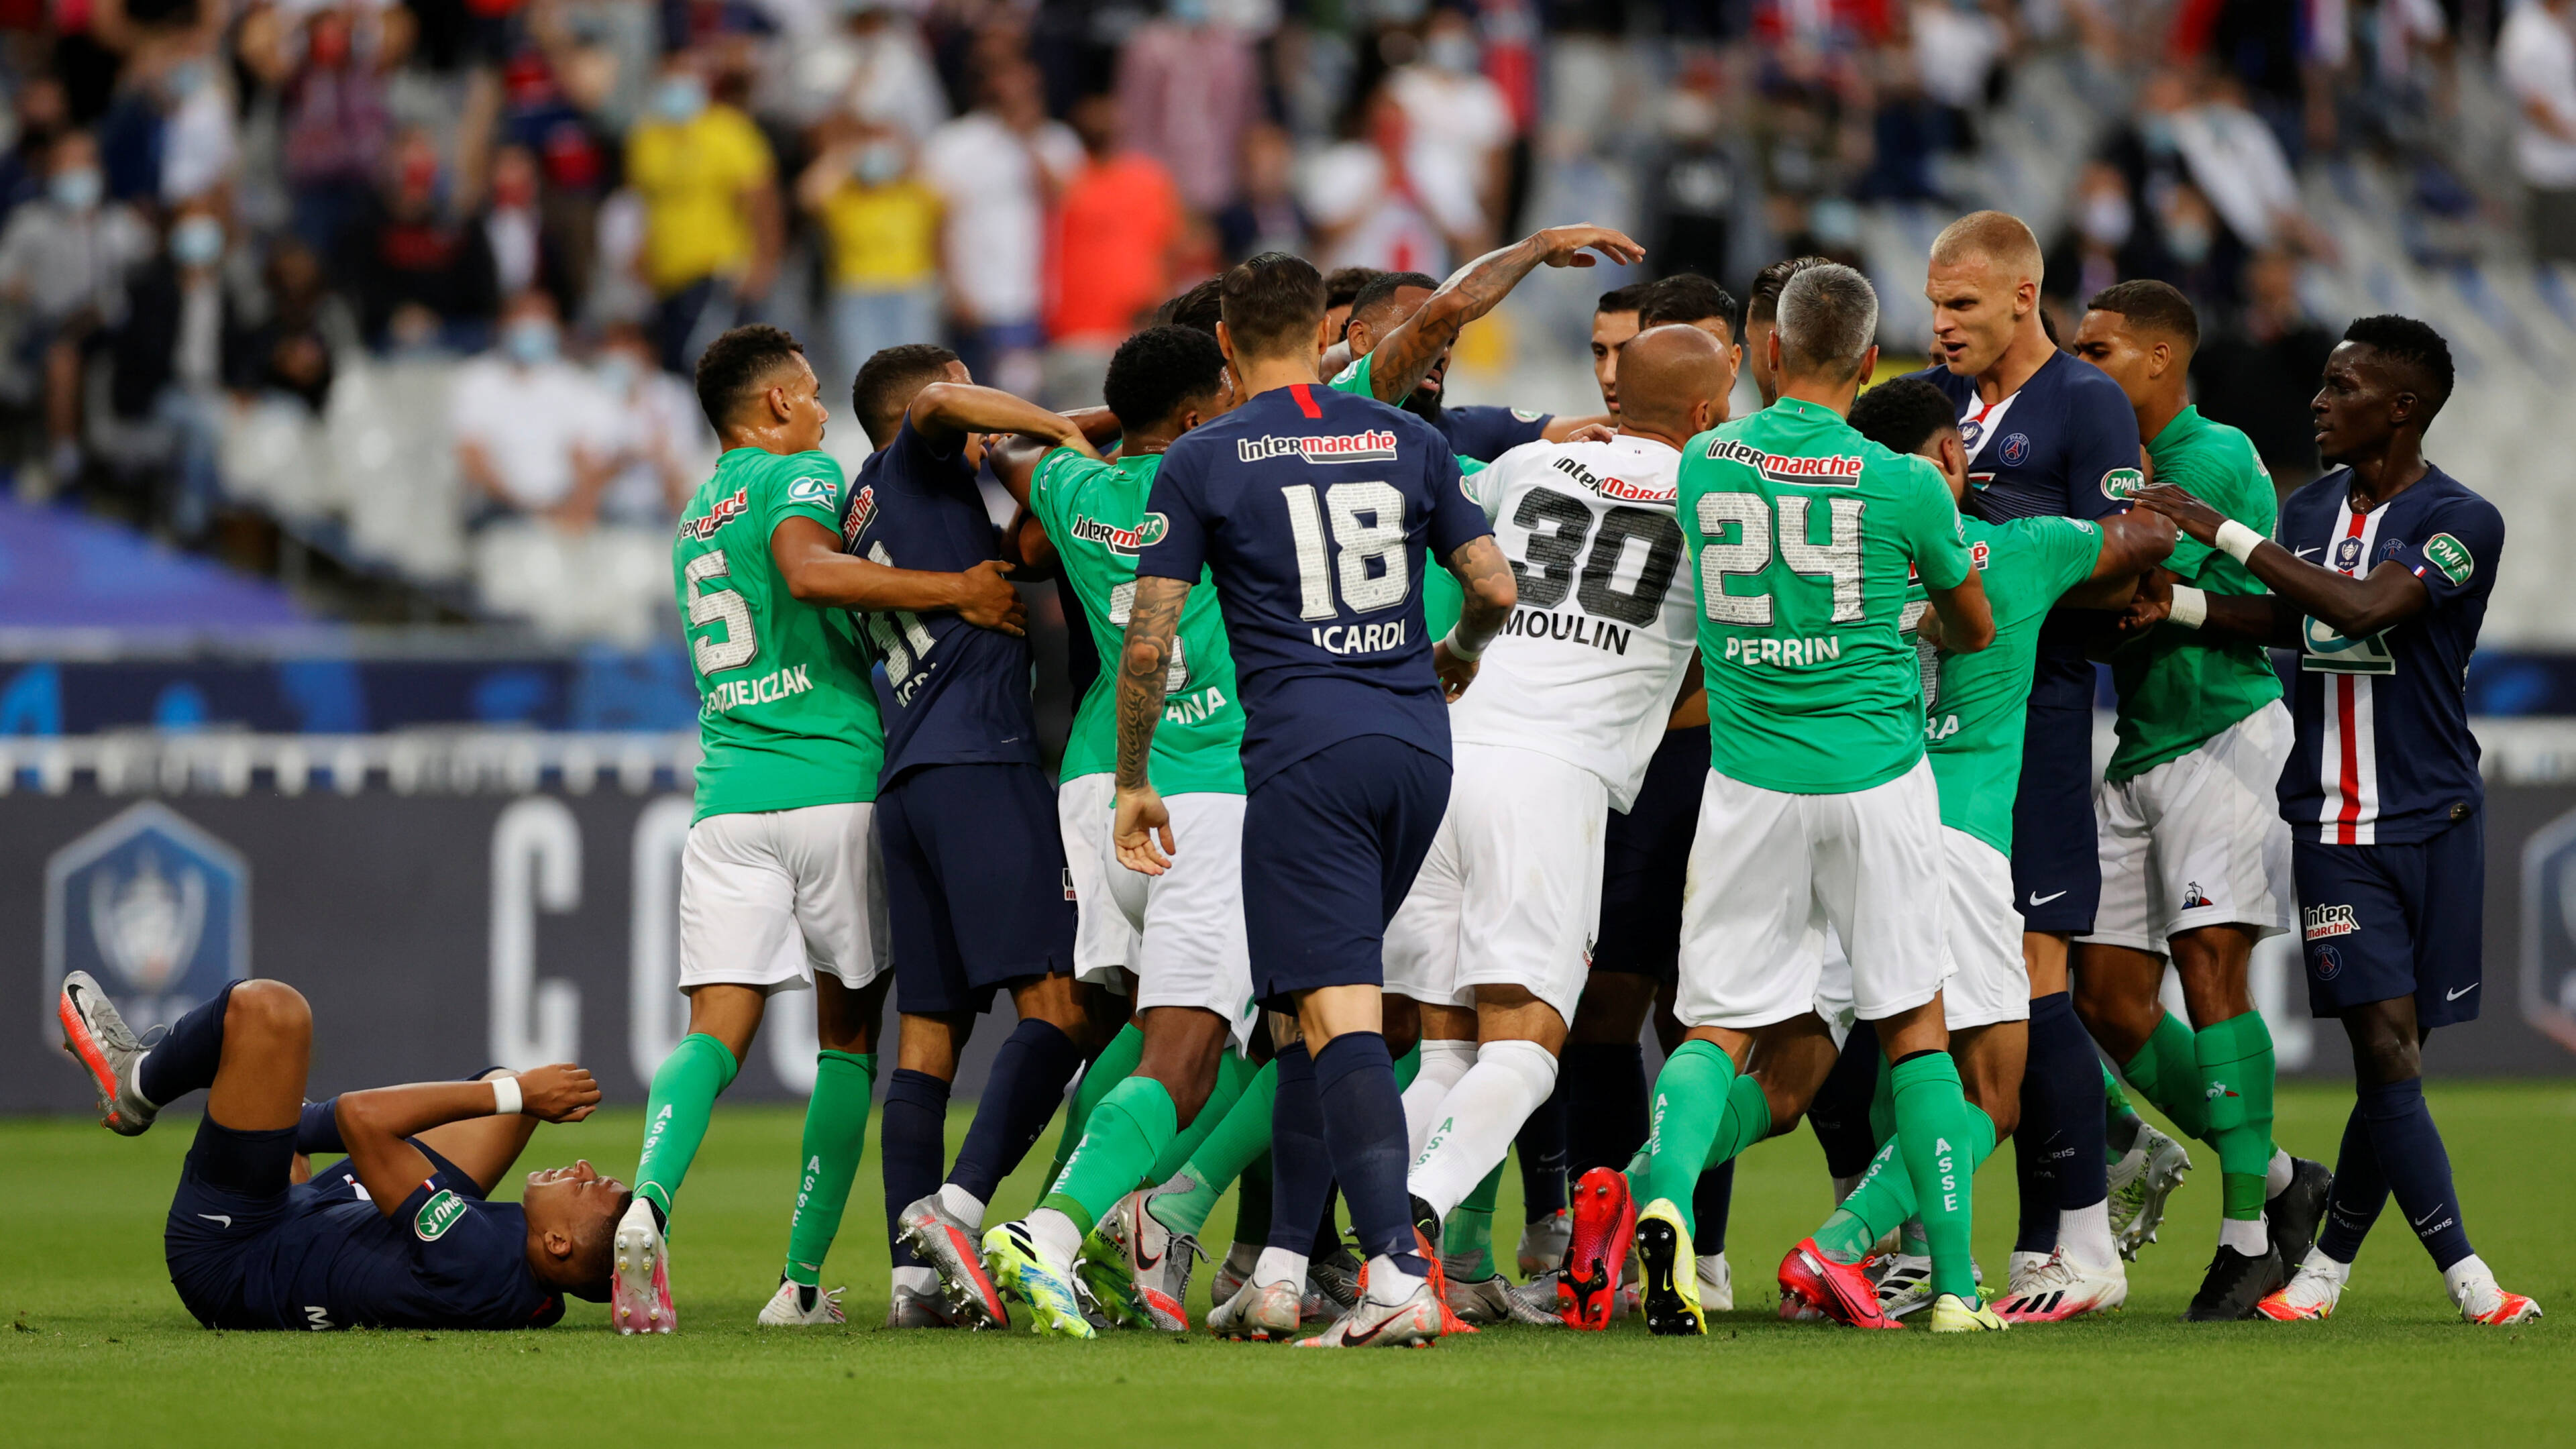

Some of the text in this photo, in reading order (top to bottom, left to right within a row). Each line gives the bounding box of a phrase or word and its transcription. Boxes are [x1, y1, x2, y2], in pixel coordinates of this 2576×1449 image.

[1281, 480, 1409, 622] 18
[1509, 486, 1685, 629] 30
[1696, 492, 1866, 627] 24
[2431, 539, 2465, 567] PMU
[684, 548, 758, 678] 5
[1311, 618, 1405, 654] ICARDI
[1499, 609, 1631, 656] MOULIN
[1725, 635, 1840, 667] PERRIN
[2306, 904, 2357, 928] Inter
[641, 1104, 672, 1165] ASSE
[1651, 1093, 1668, 1156] ASSE
[792, 1155, 820, 1227] ASSE
[1050, 1134, 1089, 1193] ASSE
[1845, 1144, 1894, 1201] ASSE
[1935, 1137, 1958, 1212] ASSE
[2421, 1218, 2453, 1237] PARIS
